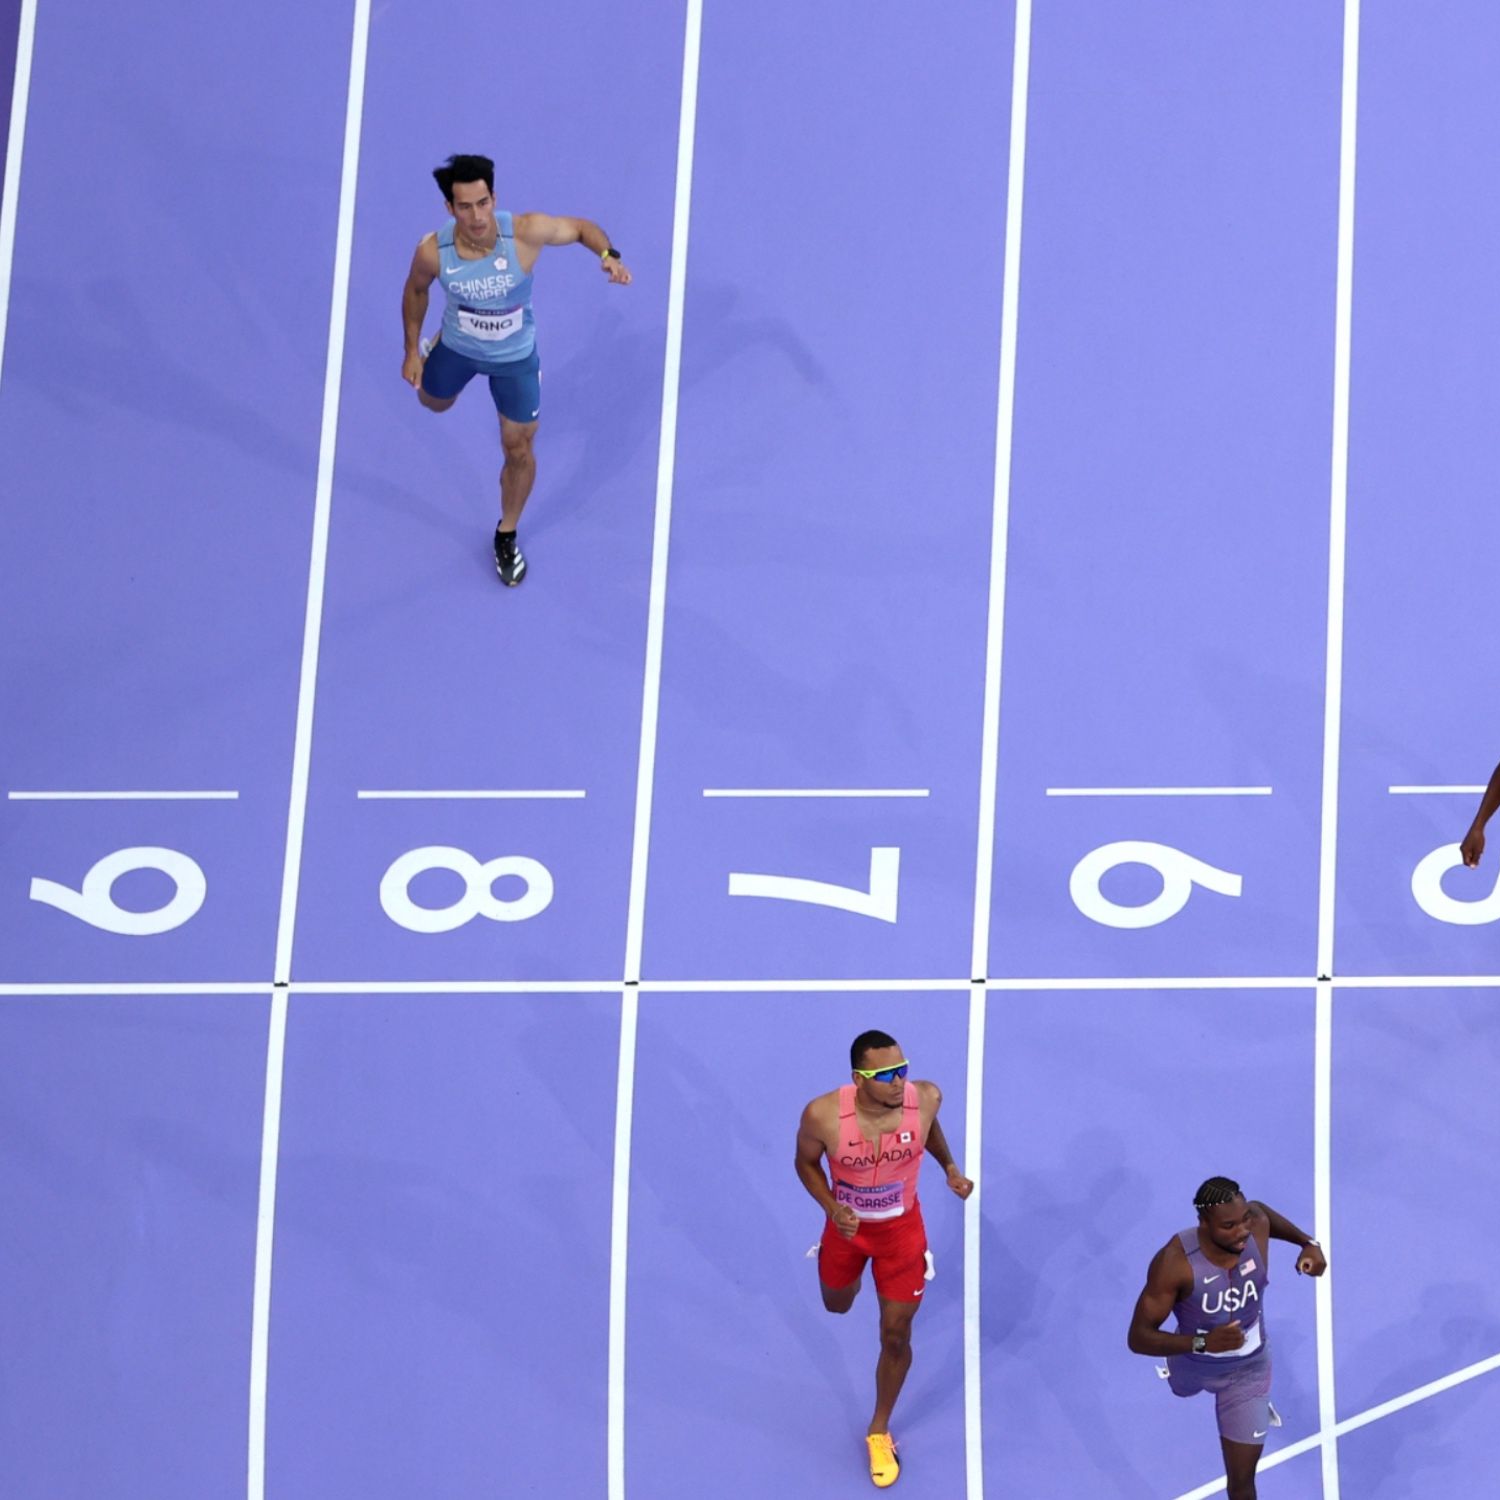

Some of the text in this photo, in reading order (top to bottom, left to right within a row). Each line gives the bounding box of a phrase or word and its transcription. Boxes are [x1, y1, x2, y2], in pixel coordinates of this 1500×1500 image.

[448, 273, 516, 295] CHINESE
[463, 287, 507, 301] TAIPEI
[29, 847, 207, 936] 9
[379, 846, 554, 933] 8
[728, 847, 900, 923] 7
[1069, 840, 1243, 929] 6
[840, 1148, 913, 1168] CANADA
[838, 1189, 901, 1209] DE GRASSE
[1202, 1280, 1258, 1314] USA
